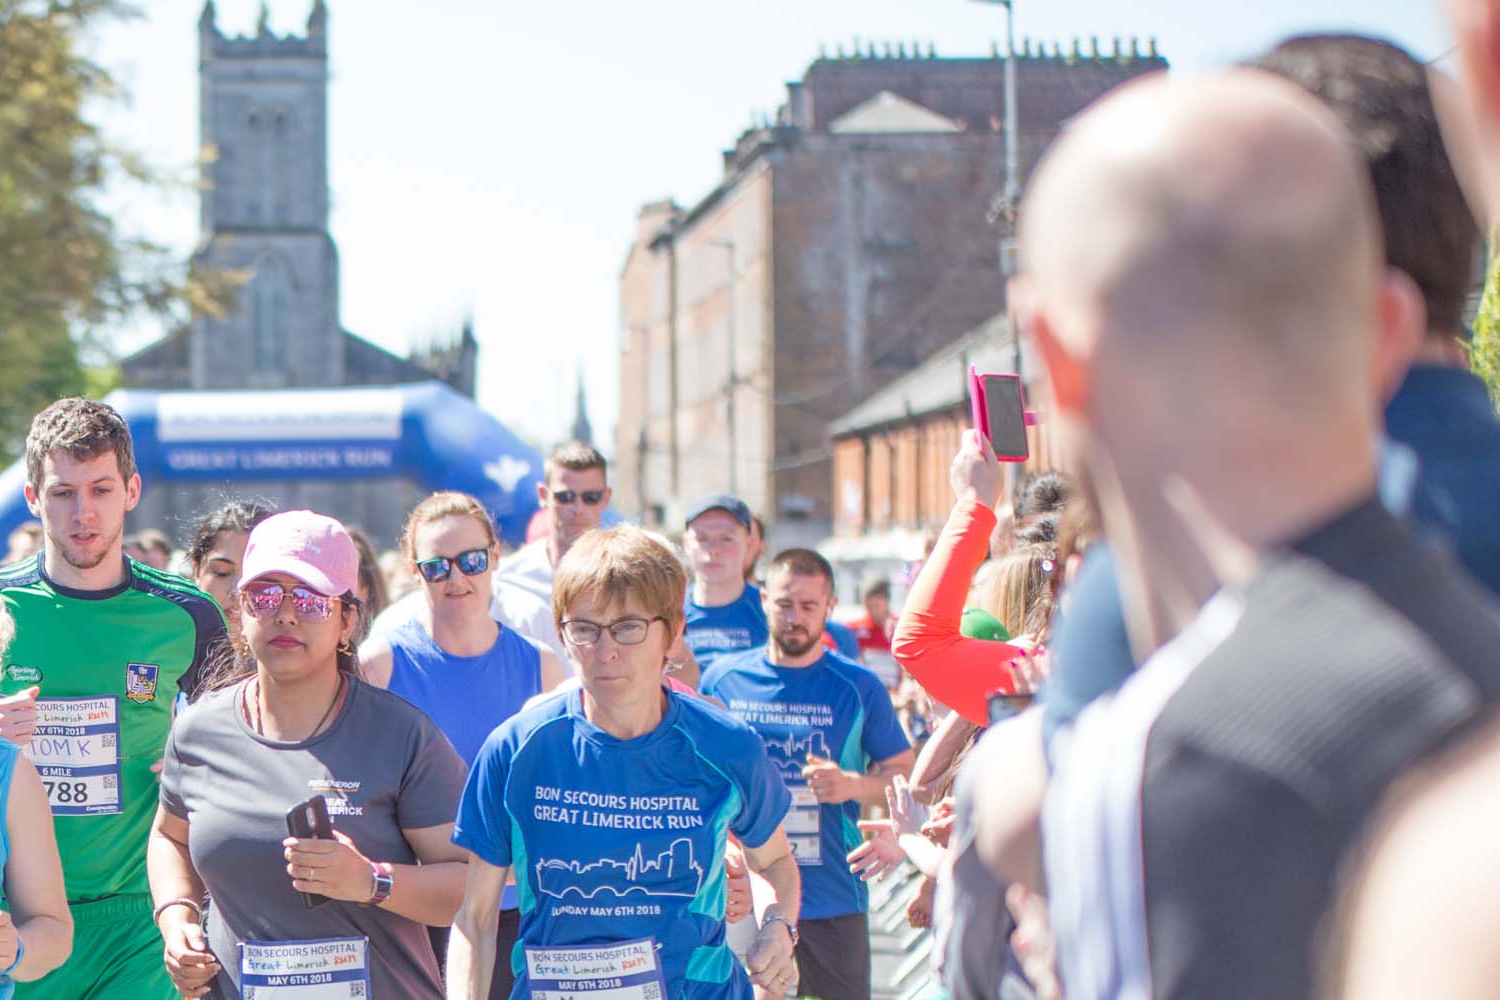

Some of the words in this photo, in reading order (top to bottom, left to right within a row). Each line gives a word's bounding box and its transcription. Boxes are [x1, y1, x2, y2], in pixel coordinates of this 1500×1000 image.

[35, 703, 64, 711] COURS
[66, 702, 109, 711] HOSPITAL
[789, 703, 832, 714] HOSPITAL
[44, 714, 83, 722] Limerick
[760, 713, 809, 726] LIMERICK
[810, 715, 833, 727] RUN
[31, 728, 46, 736] AY
[47, 727, 64, 736] 6TH
[66, 727, 86, 735] 2018
[77, 739, 92, 757] K
[42, 768, 48, 776] 6
[50, 768, 72, 776] MILE
[43, 781, 88, 803] 788
[534, 786, 561, 800] BON
[563, 790, 626, 810] SECOURS
[630, 797, 700, 811] HOSPITAL
[534, 804, 580, 824] GREAT
[582, 810, 664, 830] LIMERICK
[667, 814, 703, 830] RUN
[551, 904, 587, 917] SUNDAY
[590, 906, 613, 916] MAY
[614, 905, 634, 916] 6TH
[636, 905, 661, 915] 2018
[247, 947, 262, 957] BON
[264, 948, 309, 958] SECOURS
[311, 943, 358, 955] HOSPITAL
[532, 952, 551, 963] BON
[553, 952, 594, 962] SECOURS
[595, 946, 646, 961] HOSPITAL
[248, 959, 282, 970] Great
[286, 959, 330, 970] Limerick
[535, 963, 569, 974] Great
[572, 963, 617, 975] Limerick
[267, 976, 289, 985] MAY
[290, 975, 308, 985] 6TH
[310, 973, 332, 983] 2018
[558, 981, 576, 990] MAY
[577, 980, 597, 990] 6TH
[598, 978, 622, 989] 2018
